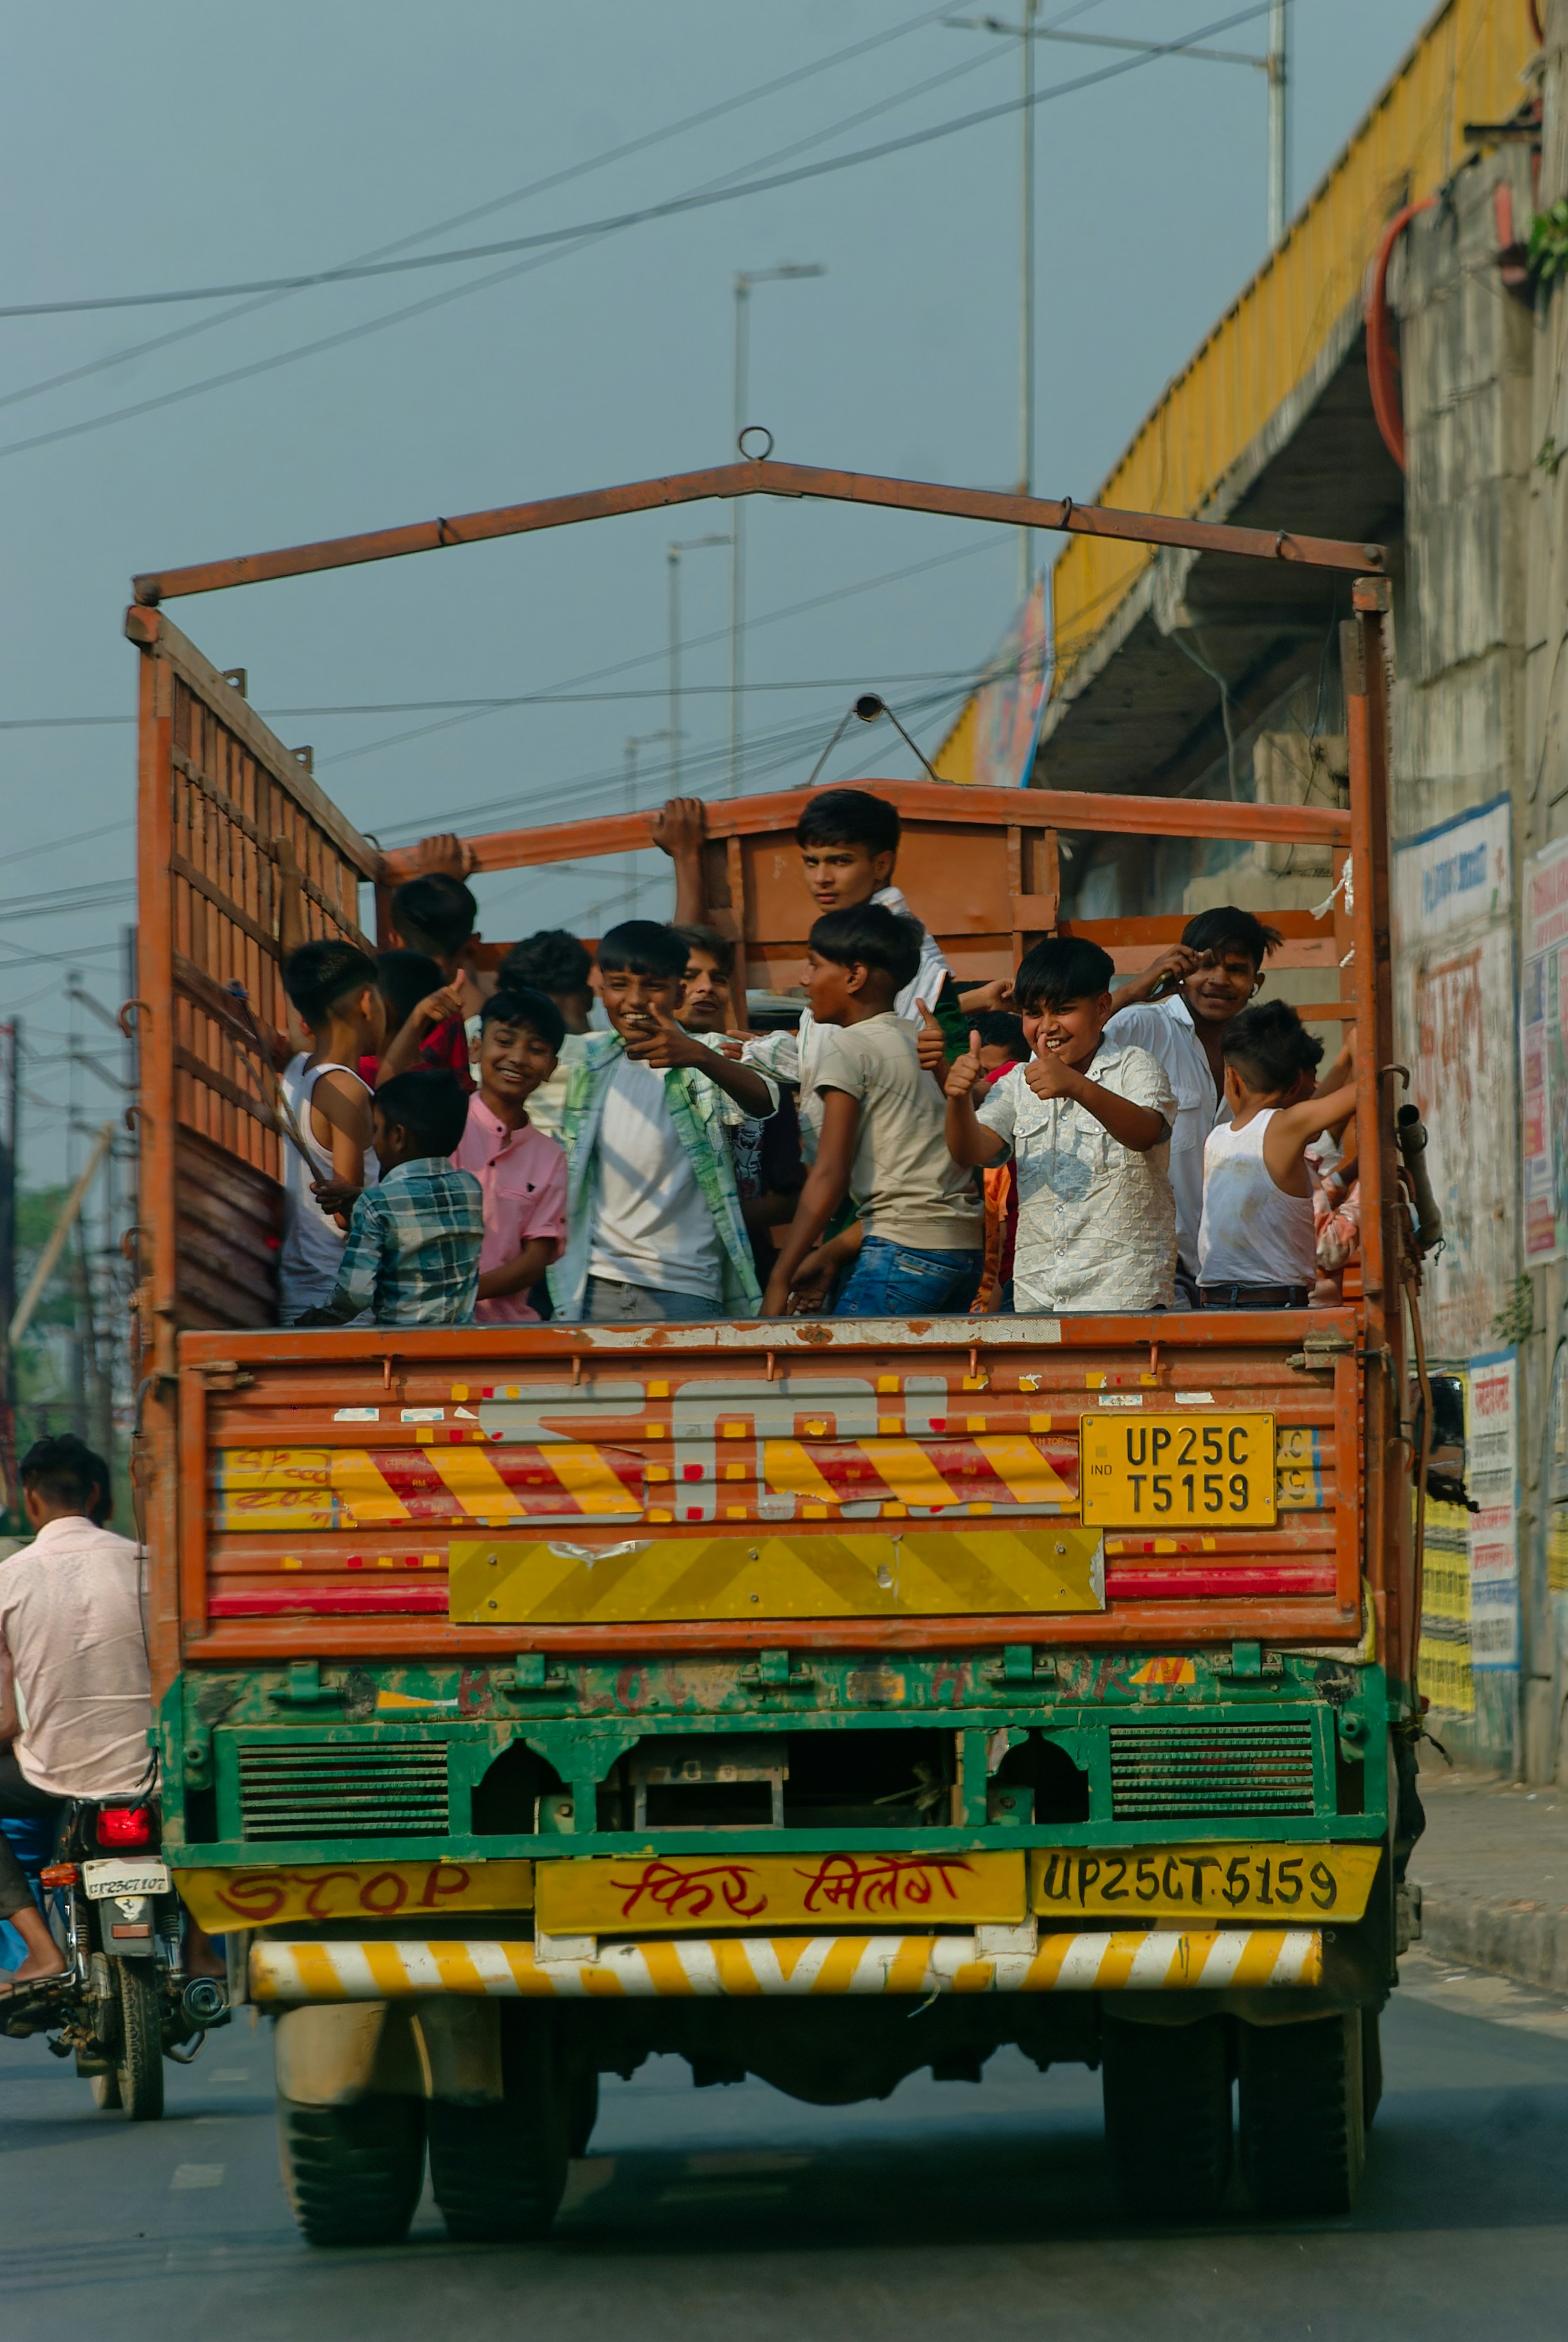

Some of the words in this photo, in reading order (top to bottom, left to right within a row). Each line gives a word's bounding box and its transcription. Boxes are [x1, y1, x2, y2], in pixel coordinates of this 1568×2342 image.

[1126, 1426, 1249, 1466] UP25C
[1091, 1464, 1112, 1475] IND
[1126, 1473, 1249, 1513] T5159
[215, 1864, 470, 1921] STOP
